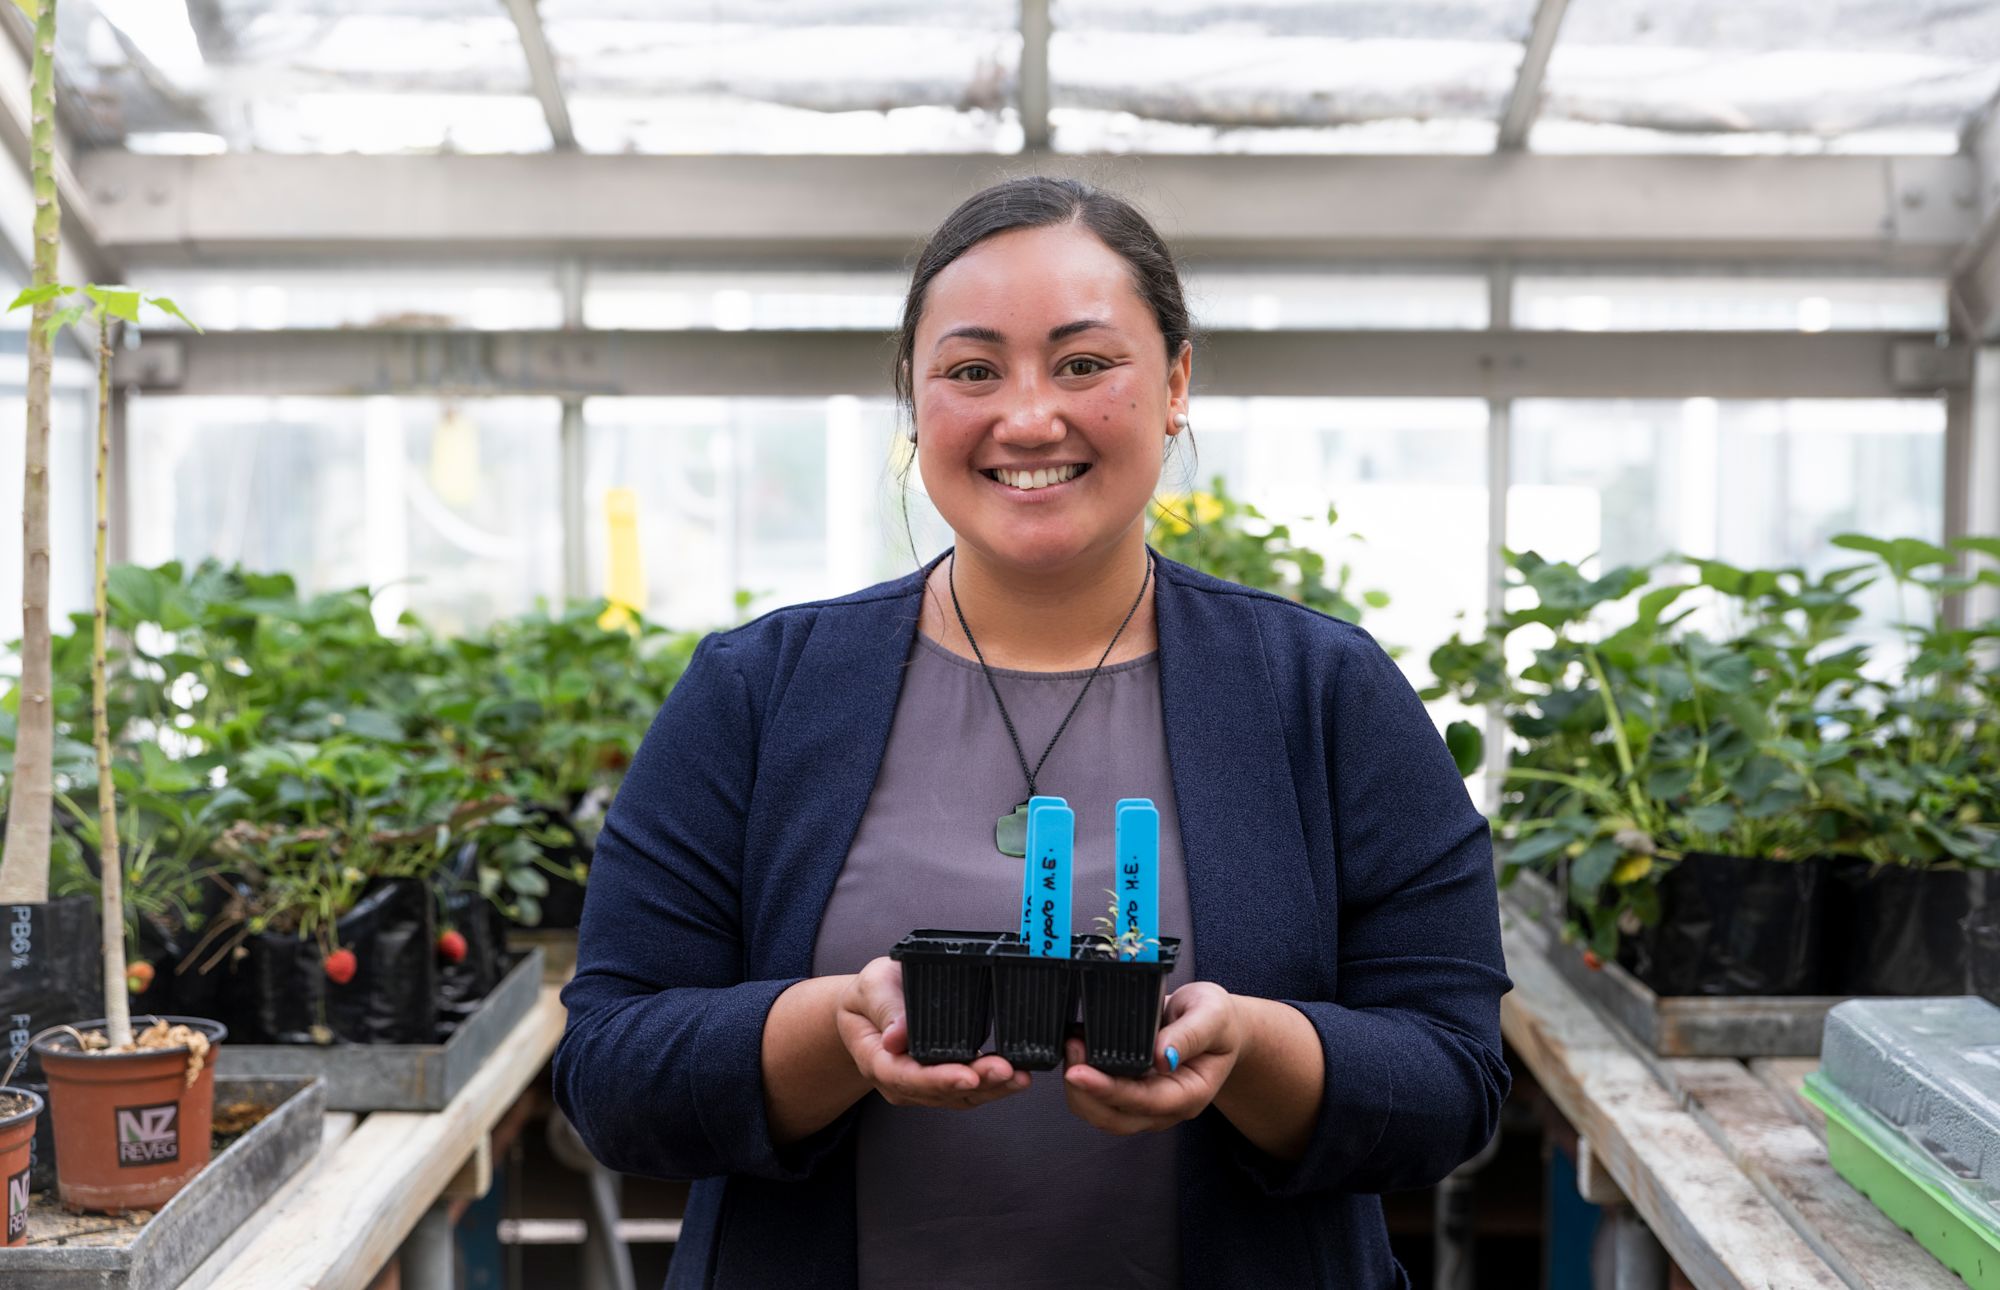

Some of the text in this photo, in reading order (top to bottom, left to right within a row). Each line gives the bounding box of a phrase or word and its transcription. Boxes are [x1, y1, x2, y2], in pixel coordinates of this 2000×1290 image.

[118, 1105, 177, 1142] NZ
[120, 1142, 177, 1162] REVEG
[10, 1169, 30, 1216] N
